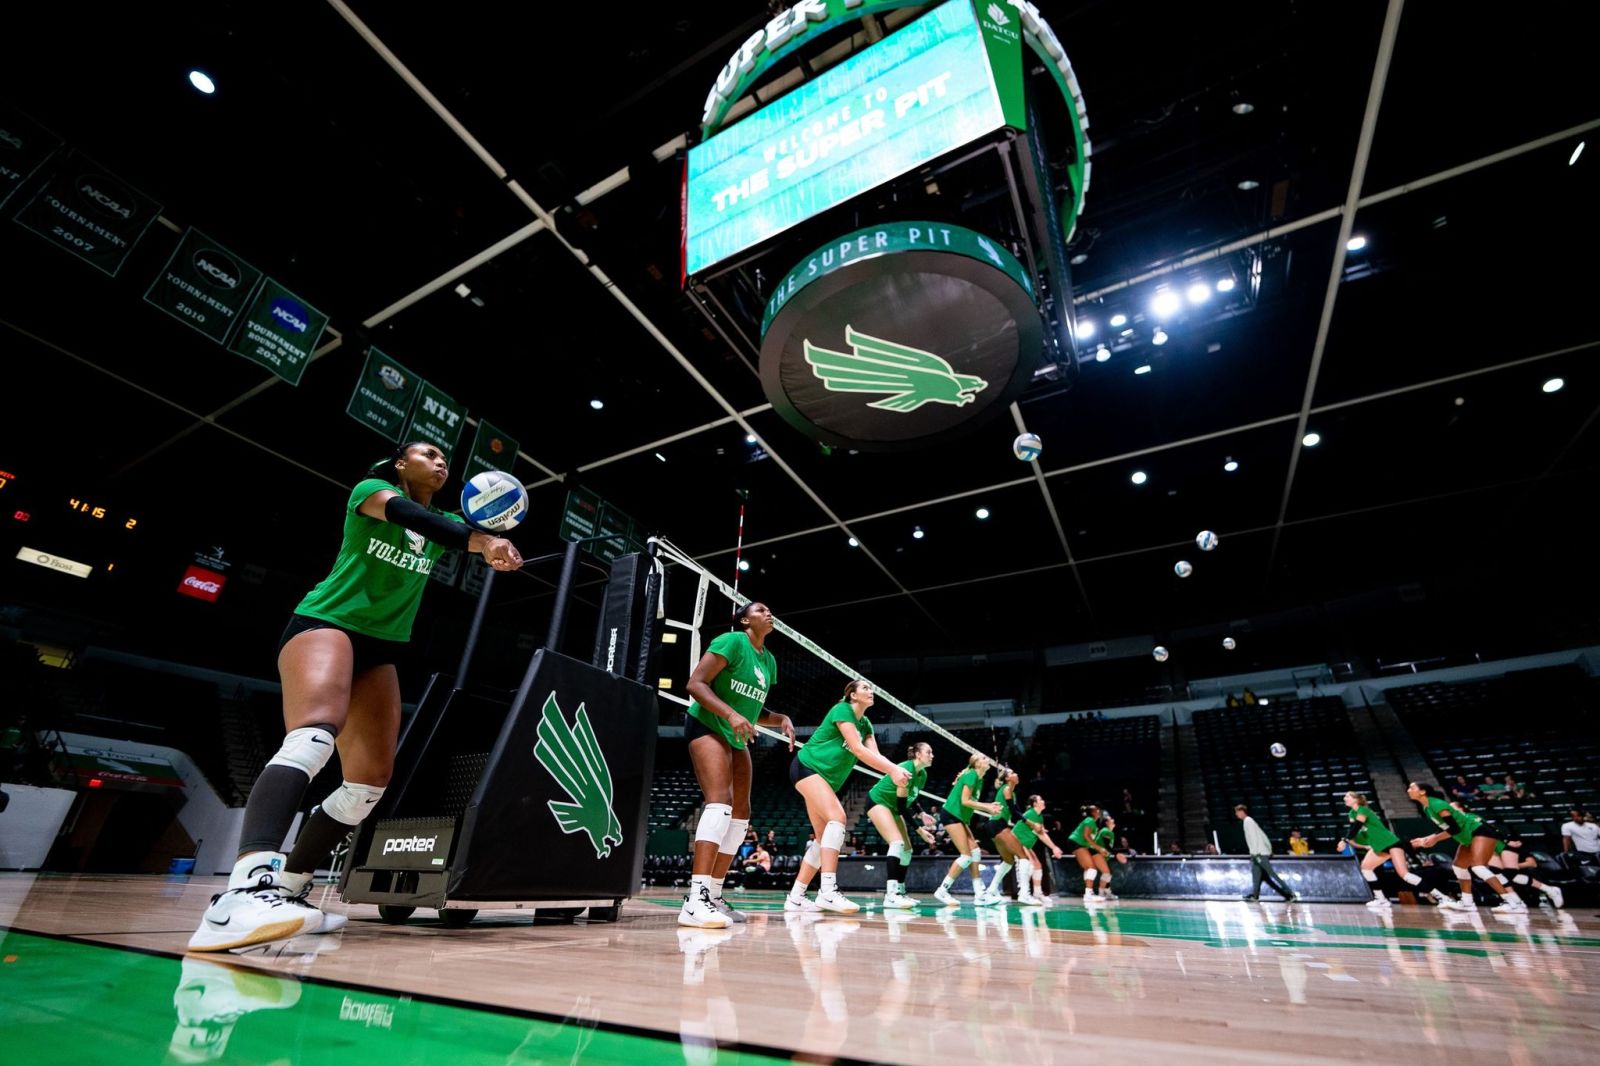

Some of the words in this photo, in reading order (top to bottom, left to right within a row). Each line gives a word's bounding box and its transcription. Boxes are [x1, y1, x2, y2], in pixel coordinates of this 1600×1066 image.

[763, 105, 851, 162] WELCOME
[863, 87, 888, 110] TO
[712, 168, 769, 212] THE
[777, 109, 887, 180] SUPER
[894, 72, 951, 119] PIT
[80, 184, 131, 219] NCAA
[46, 195, 127, 248] TOURNAMENT
[52, 225, 95, 251] 2007
[197, 258, 238, 288] NCAA
[769, 274, 797, 315] THE
[808, 231, 888, 276] SUPER
[909, 227, 951, 246] PIT
[166, 272, 234, 318] TOURNAMENT
[175, 302, 206, 324] 2010
[272, 306, 307, 332] NCAA
[247, 320, 306, 358] TOURNAMENT
[247, 331, 277, 350] ROUND
[256, 346, 282, 366] 2021
[360, 387, 405, 418] CHAMPIONS
[422, 395, 460, 428] NIT
[125, 518, 137, 530] 2
[487, 503, 521, 526] molten
